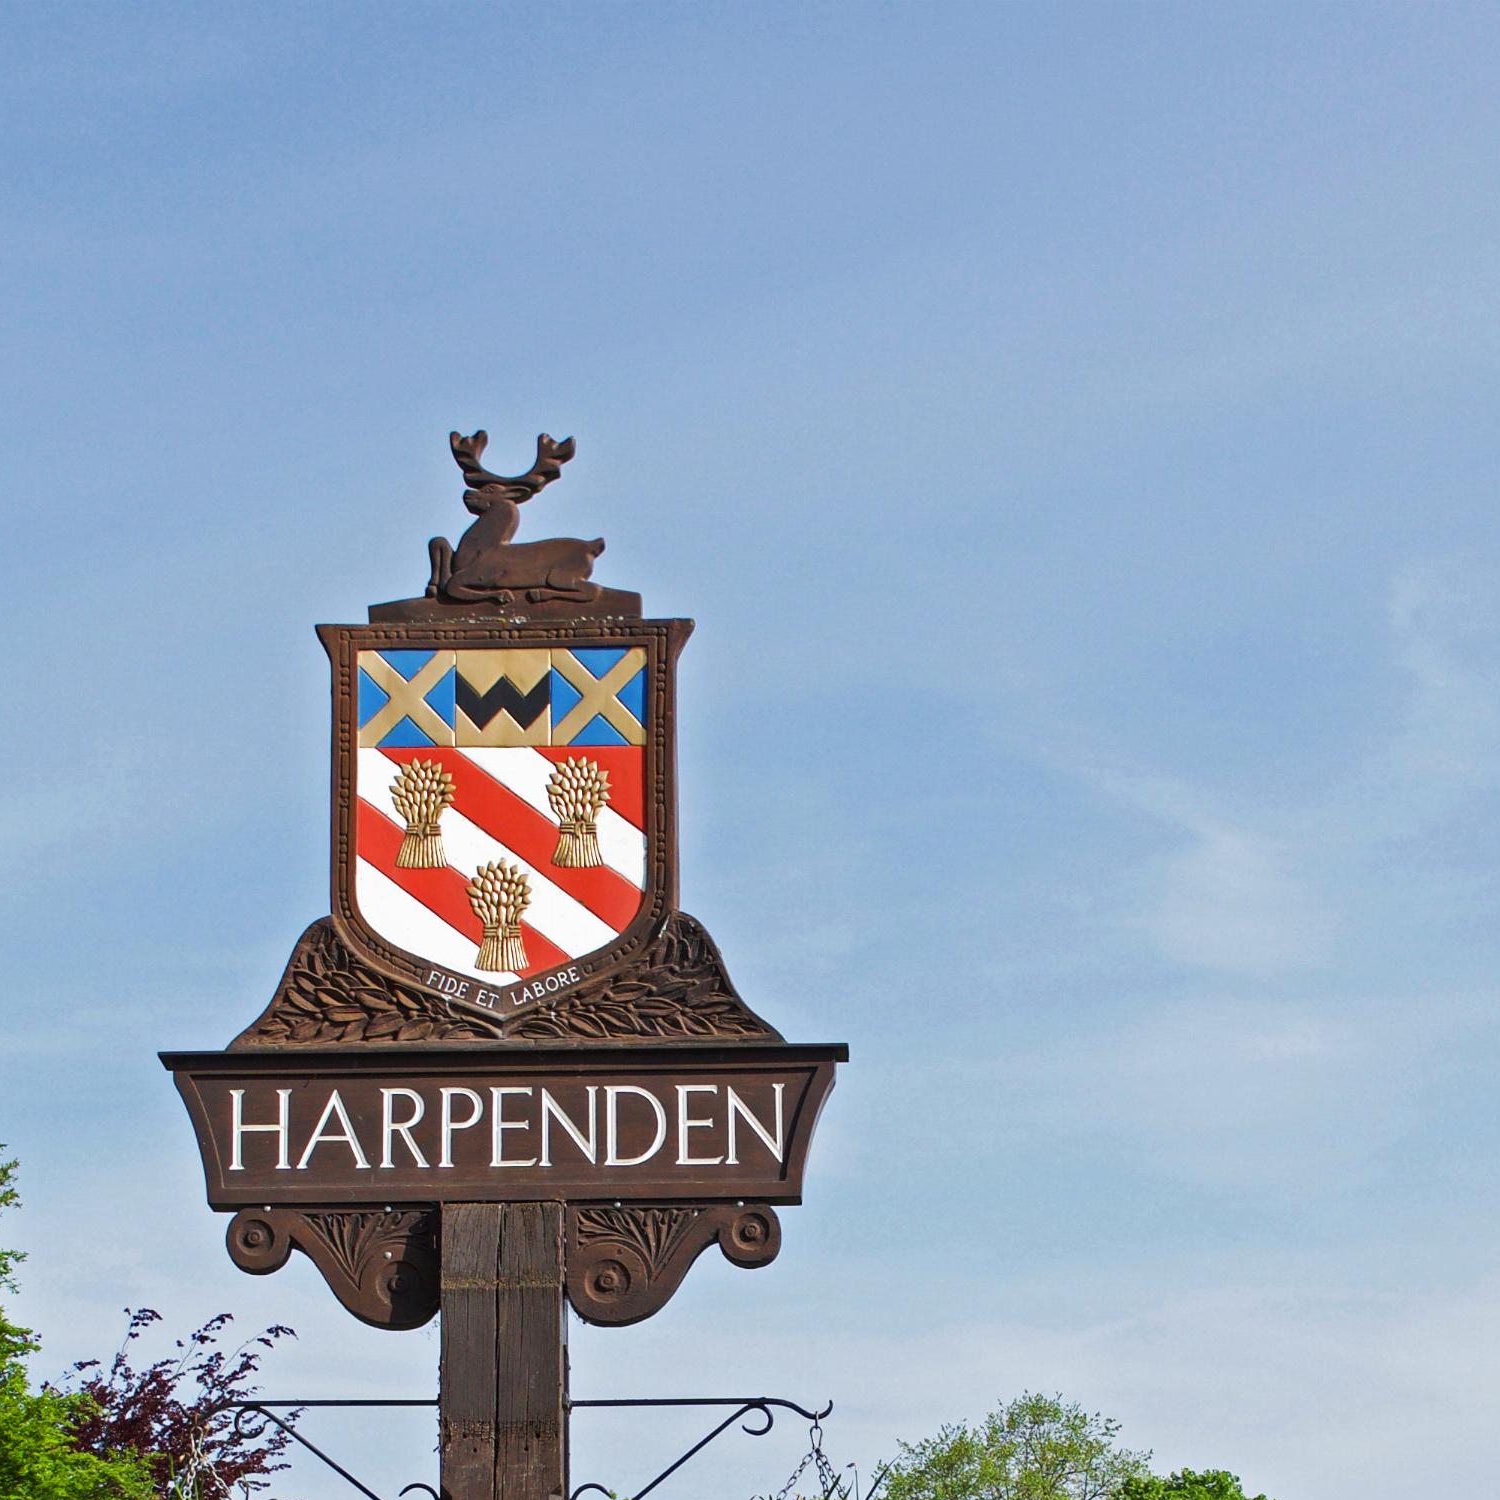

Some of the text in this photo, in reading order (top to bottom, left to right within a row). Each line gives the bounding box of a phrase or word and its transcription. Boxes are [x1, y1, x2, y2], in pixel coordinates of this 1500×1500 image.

[426, 966, 581, 1009] FIDE ET LABORE
[228, 1082, 786, 1171] HARPENDEN
